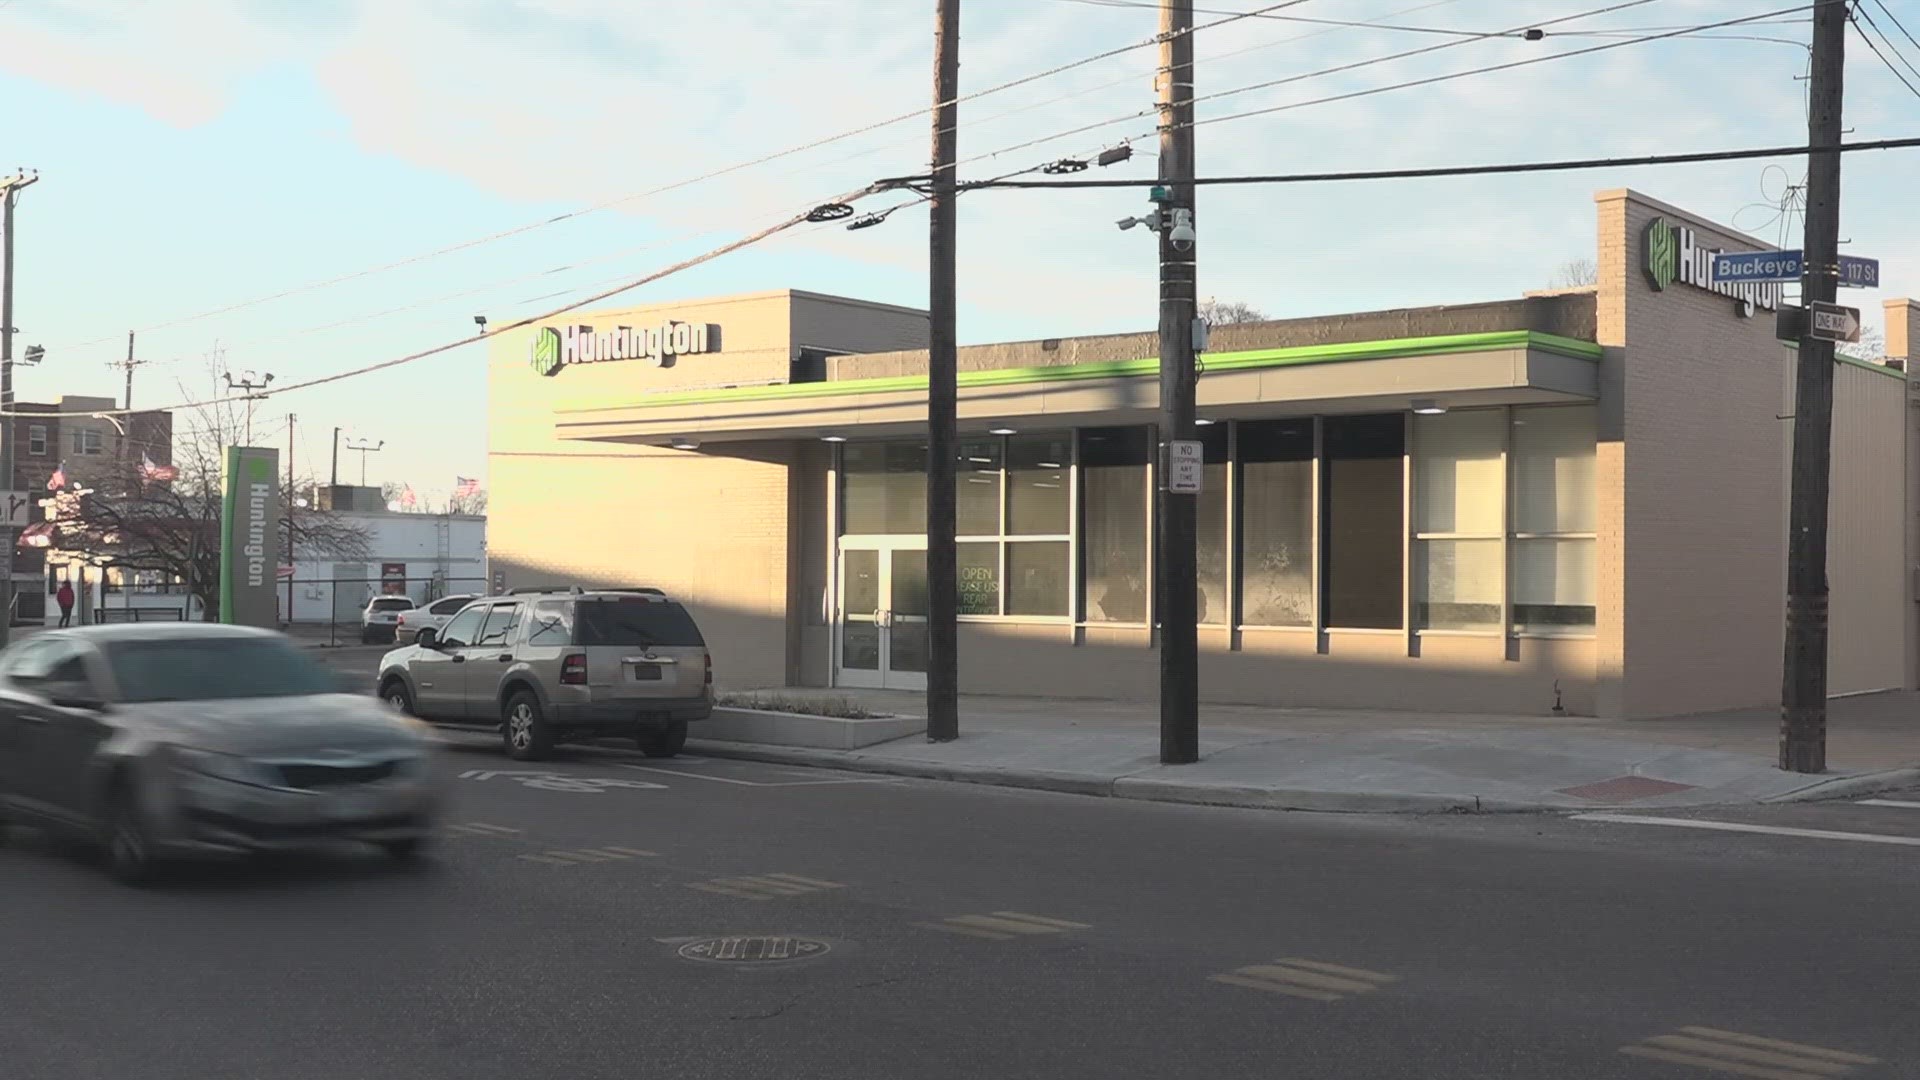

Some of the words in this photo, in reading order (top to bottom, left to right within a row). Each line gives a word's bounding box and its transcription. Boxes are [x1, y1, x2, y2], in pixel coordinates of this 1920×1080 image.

[1718, 257, 1797, 276] Buckeye
[1847, 262, 1863, 280] 117
[1864, 264, 1876, 282] St
[1817, 313, 1830, 329] ONE
[1832, 315, 1847, 330] WAY
[561, 320, 707, 367] Huntington
[1180, 445, 1193, 456] NO
[1180, 465, 1193, 473] ANY
[244, 483, 269, 586] Huntington
[962, 567, 992, 580] OPEN
[957, 581, 982, 592] EASE
[963, 593, 988, 605] REAR
